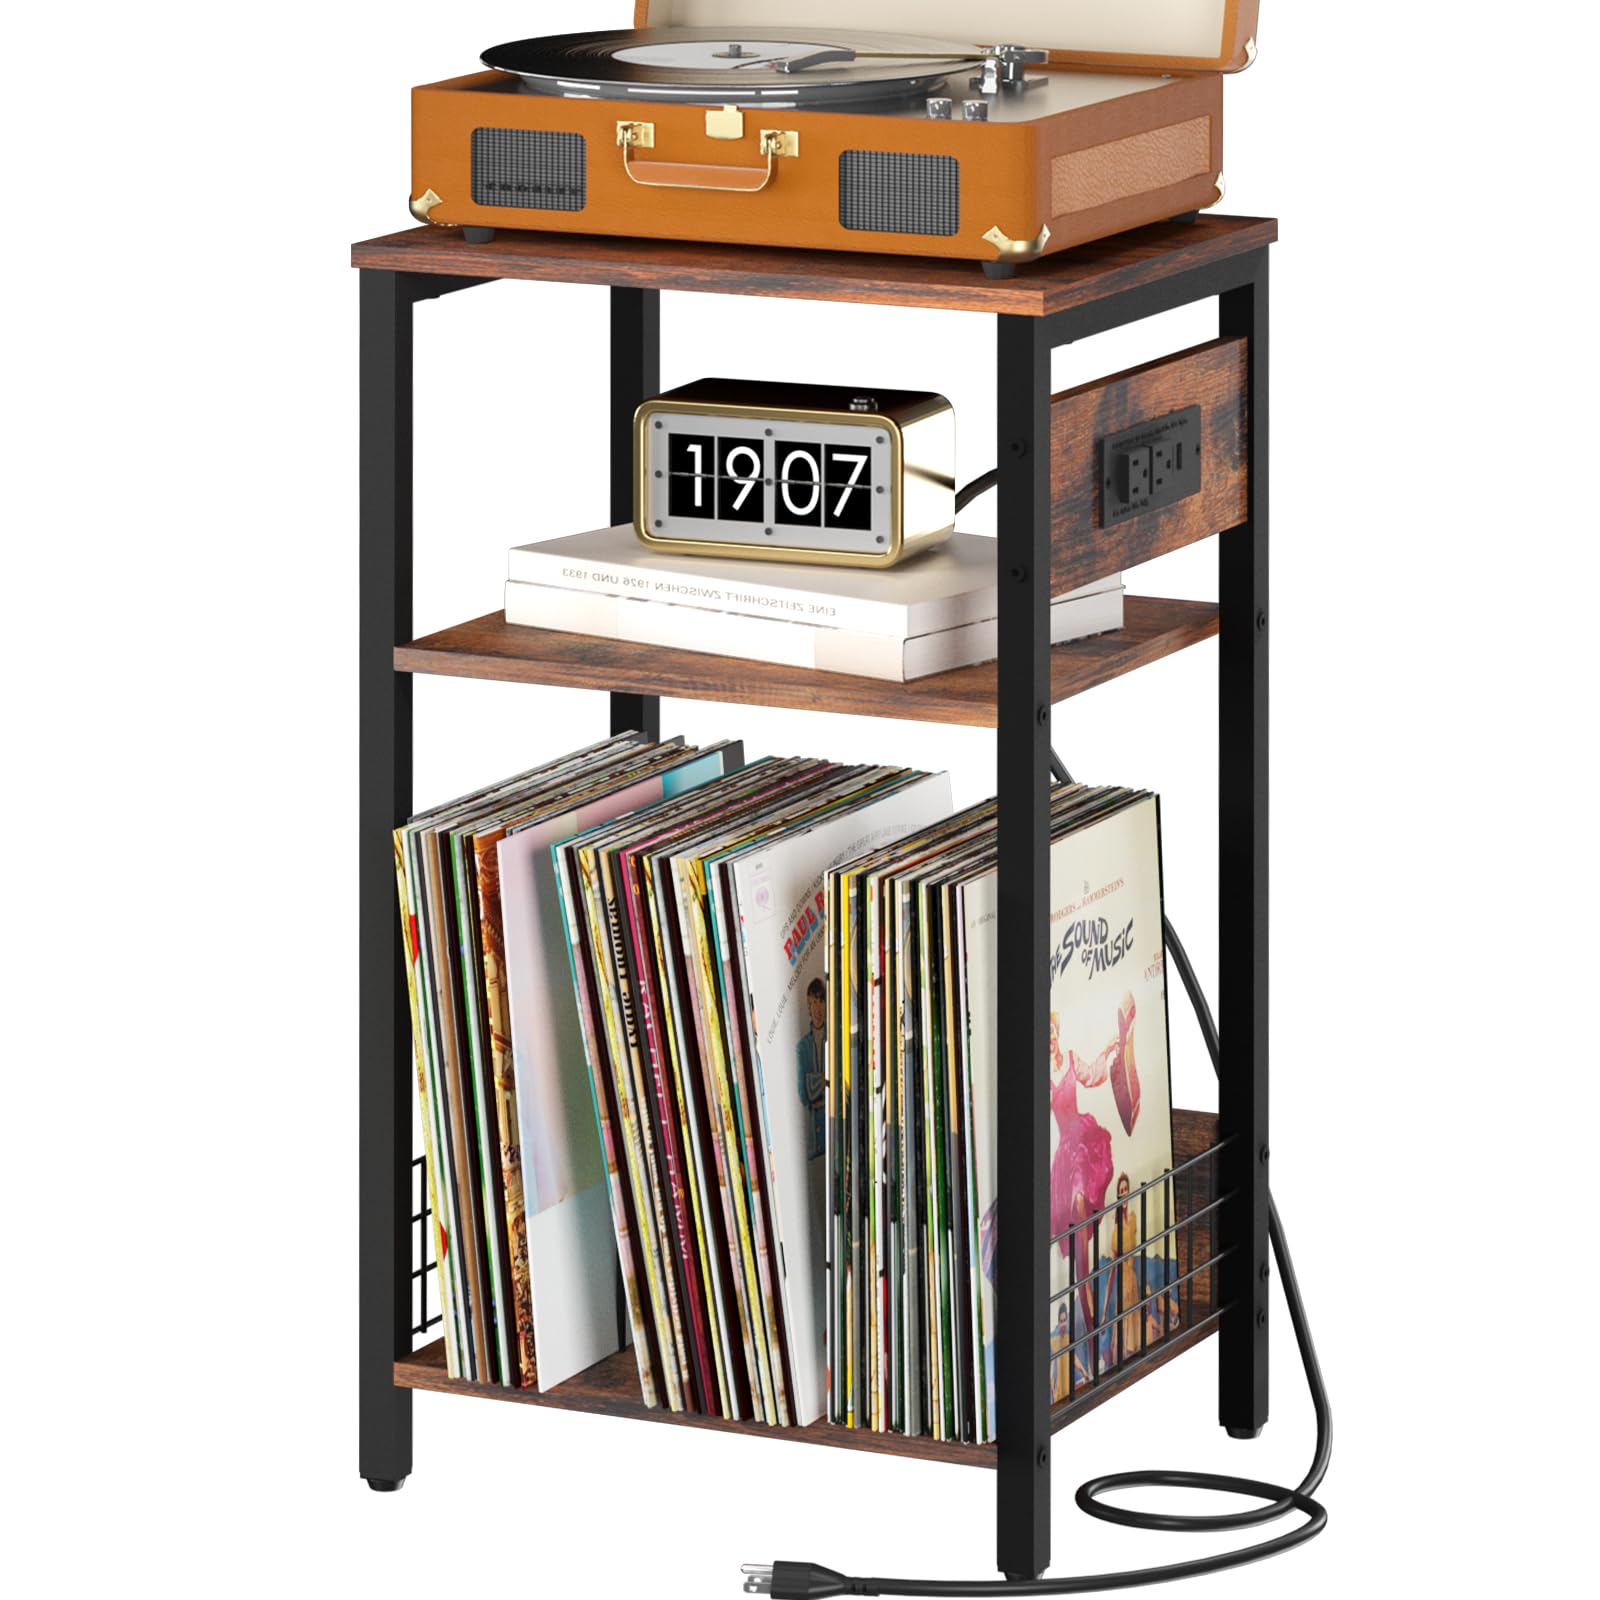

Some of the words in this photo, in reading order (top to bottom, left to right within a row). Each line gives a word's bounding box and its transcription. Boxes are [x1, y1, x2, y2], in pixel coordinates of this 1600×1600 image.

[783, 905, 817, 961] PAUL
[1050, 944, 1062, 982] HE
[1060, 917, 1108, 976] SOUND
[1081, 948, 1093, 967] OF
